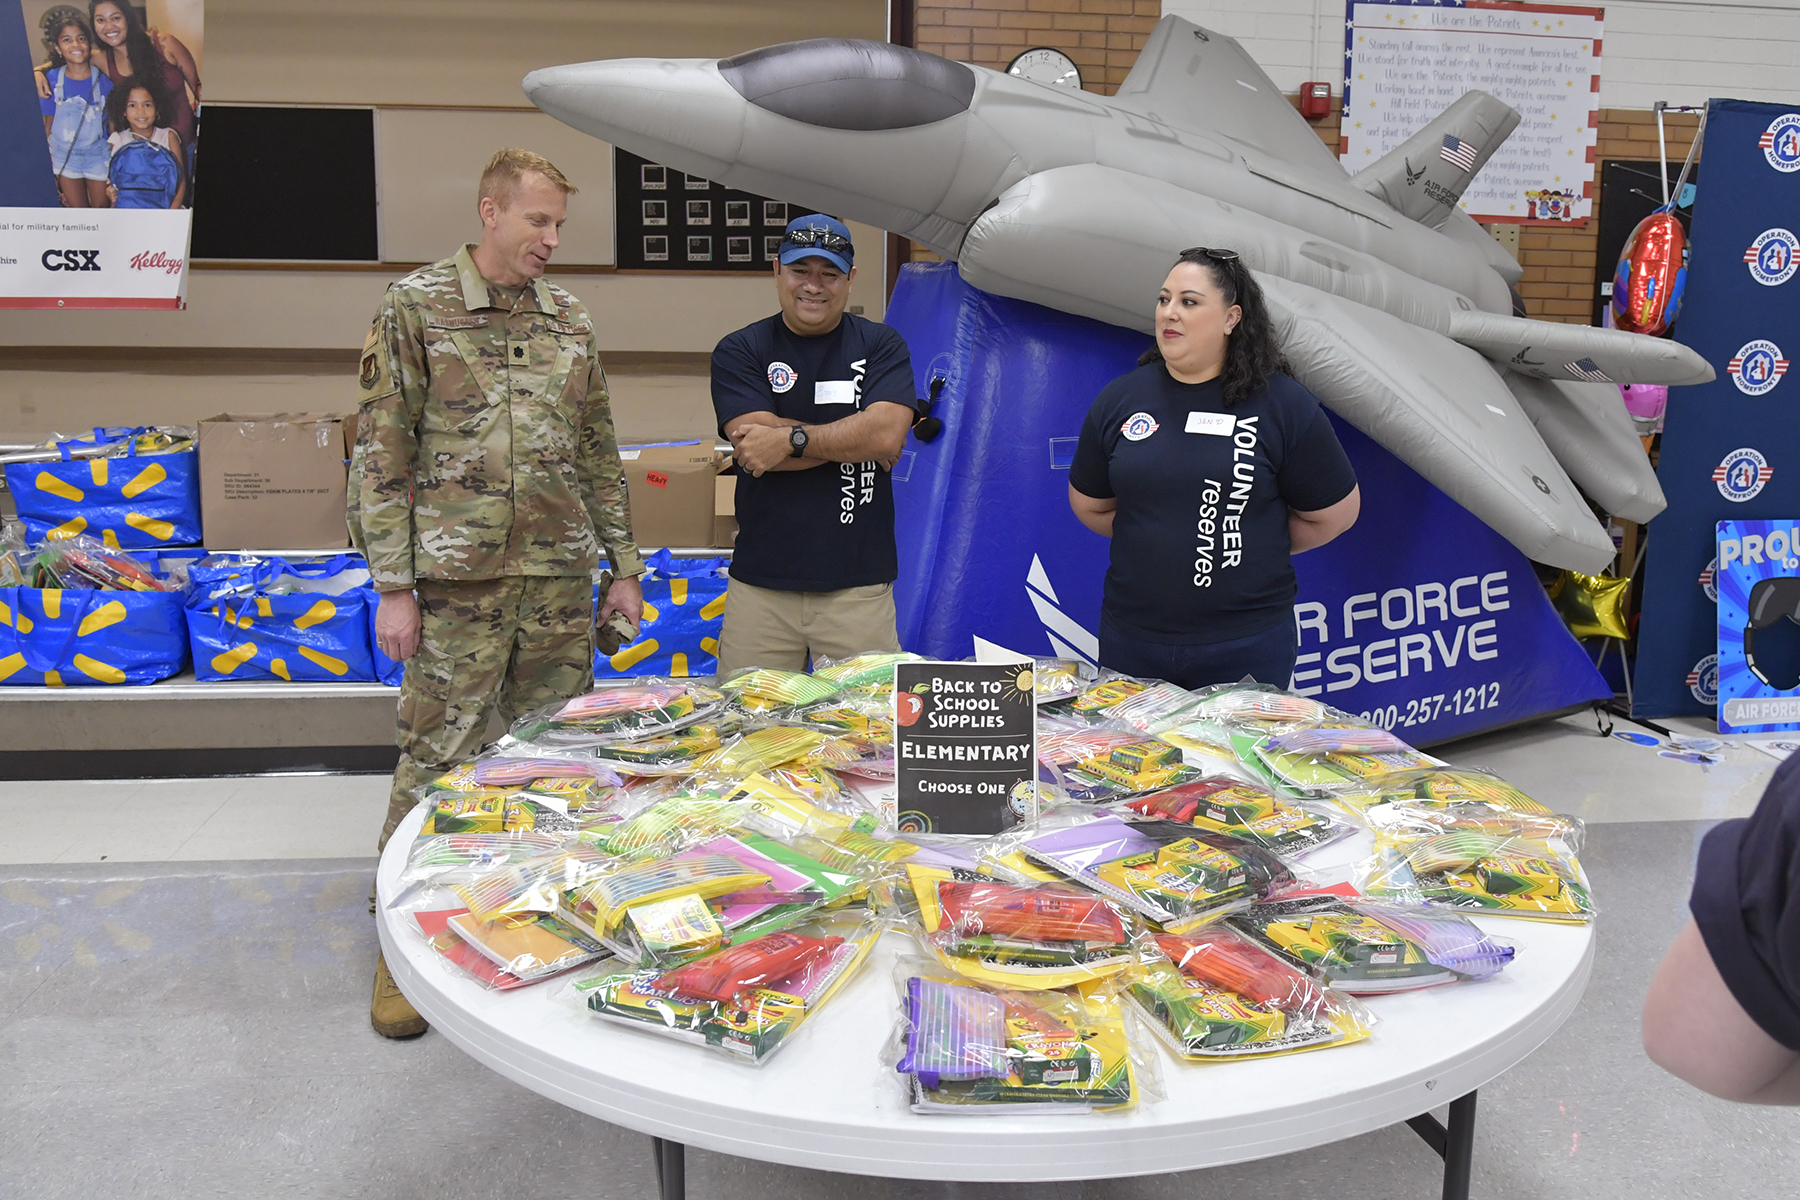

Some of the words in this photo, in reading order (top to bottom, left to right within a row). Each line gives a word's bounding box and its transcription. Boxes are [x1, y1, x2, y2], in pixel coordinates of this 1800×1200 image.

[1432, 12, 1447, 26] We
[1451, 17, 1466, 26] are
[1470, 14, 1482, 27] the
[1487, 14, 1521, 30] Patriots
[1368, 38, 1400, 52] Standing
[1402, 40, 1413, 51] tall
[1415, 44, 1440, 54] among
[1442, 42, 1453, 52] the
[1478, 43, 1491, 54] We
[1494, 46, 1526, 57] represent
[1024, 55, 1033, 63] 11
[1040, 52, 1050, 60] 12
[1358, 53, 1372, 64] We
[1374, 54, 1394, 65] stand
[1397, 54, 1408, 67] for
[1412, 56, 1431, 66] truth
[1434, 56, 1446, 67] and
[1486, 58, 1492, 68] A
[1494, 60, 1511, 72] good
[1512, 62, 1539, 73] example
[1542, 62, 1552, 74] for
[1554, 62, 1562, 73] all
[1564, 64, 1572, 74] to
[1384, 68, 1398, 80] We
[1400, 72, 1414, 80] are
[1416, 70, 1428, 81] the
[1466, 71, 1478, 82] the
[1480, 73, 1503, 86] mighty
[1505, 75, 1528, 87] mighty
[1375, 82, 1406, 96] Working
[1408, 84, 1426, 95] hand
[1492, 88, 1503, 98] the
[1536, 92, 1568, 102] awesome
[1390, 98, 1402, 110] Hill
[1404, 98, 1420, 110] Field
[1424, 98, 1450, 110] Patriot
[1383, 112, 1395, 122] We
[1400, 112, 1414, 124] help
[1533, 120, 1553, 130] peace
[1772, 117, 1800, 132] OPERAT
[1366, 126, 1380, 137] and
[1382, 127, 1399, 138] plant
[1537, 135, 1563, 144] respect
[1520, 146, 1532, 156] the
[1768, 150, 1800, 169] HOMEFRO
[1500, 162, 1520, 172] mighty
[1424, 180, 1440, 192] AIR
[1514, 177, 1544, 186] awesome
[1474, 188, 1498, 200] proudly
[12, 222, 24, 230] for
[26, 223, 60, 232] military
[62, 224, 99, 232] families!
[1757, 231, 1796, 248] OPERATION
[41, 249, 101, 271] CSX
[130, 250, 183, 275] Kellogg
[1752, 264, 1793, 282] HOMEFRONT
[1740, 343, 1779, 358] OPERATION
[1736, 375, 1776, 392] HOMEFRONT
[1197, 416, 1213, 425] JEN
[1725, 451, 1763, 466] OPERATION
[646, 474, 668, 485] HEAVY
[1221, 416, 1259, 570] VOLUNTEER
[1720, 482, 1760, 499] HOMEFRONT
[1193, 478, 1222, 588] reserves
[1719, 526, 1800, 571] PROU
[1782, 556, 1799, 569] to
[1343, 570, 1510, 639] FORCE
[1288, 619, 1498, 698] ESERVE
[931, 677, 975, 694] BACK
[934, 694, 1000, 711] SCHOOL
[1736, 702, 1759, 720] AIR
[928, 712, 1005, 728] SUPPLIES
[902, 741, 1030, 762] ELEMENTARY
[918, 780, 973, 794] CHOOSE
[977, 782, 1006, 795] ONE
[1122, 854, 1156, 866] Cray
